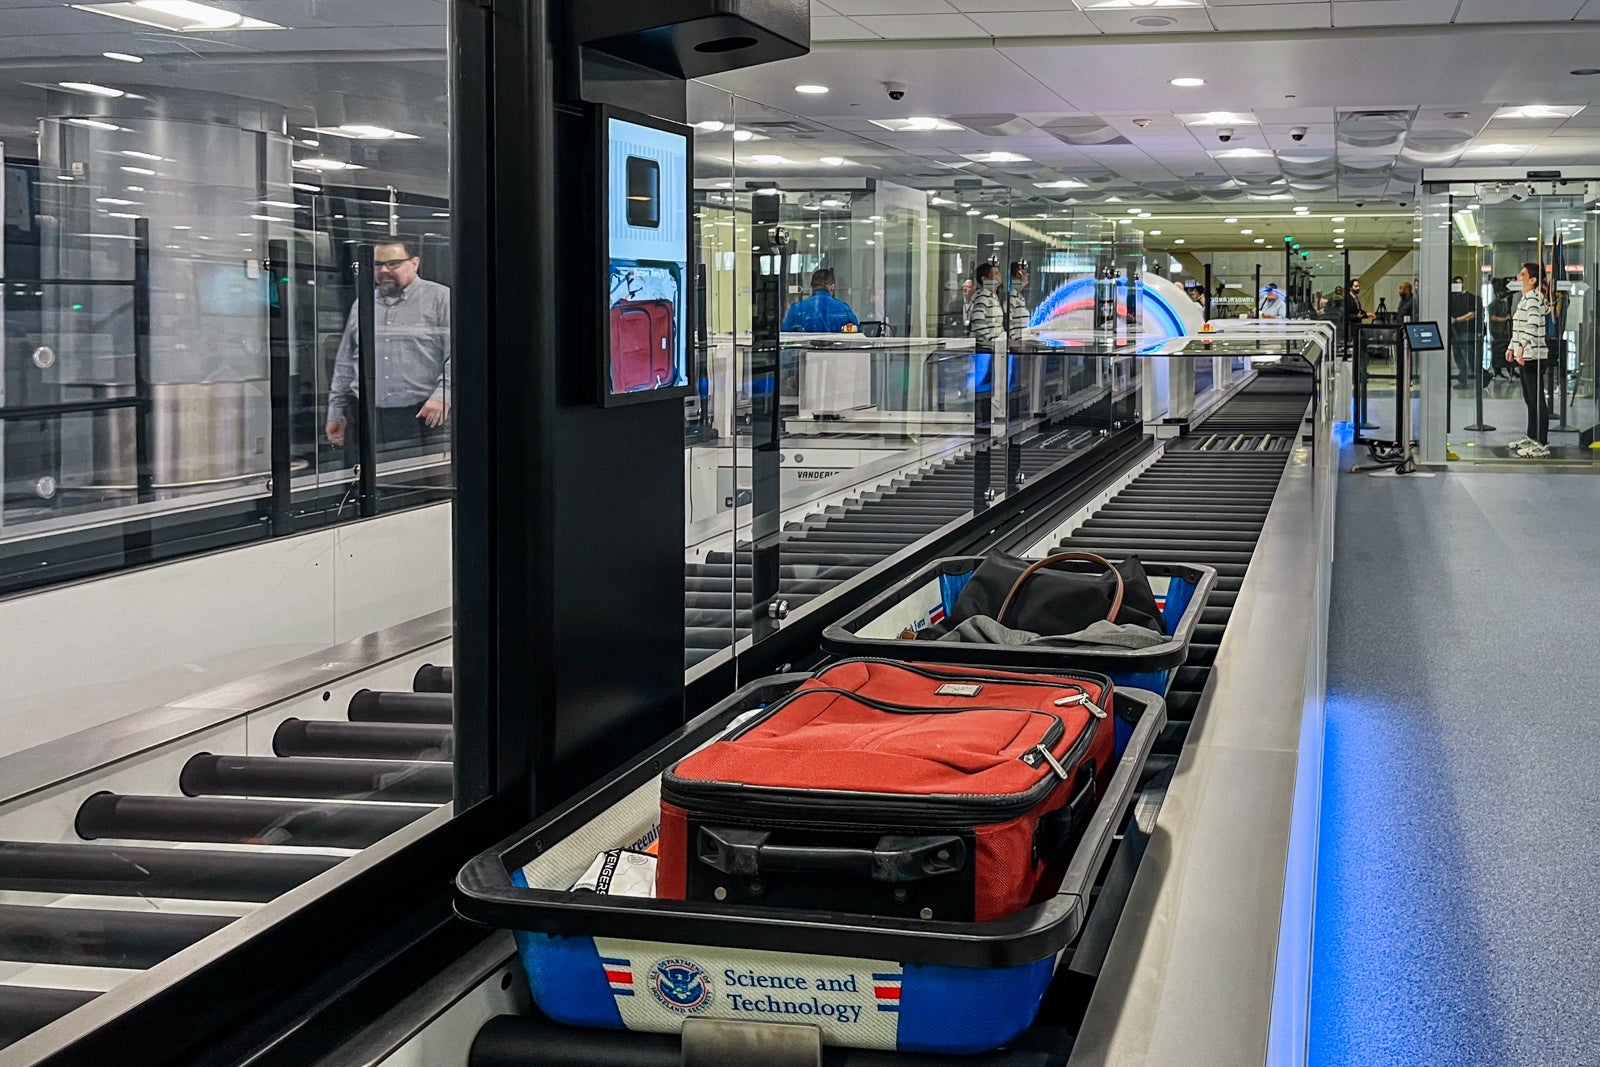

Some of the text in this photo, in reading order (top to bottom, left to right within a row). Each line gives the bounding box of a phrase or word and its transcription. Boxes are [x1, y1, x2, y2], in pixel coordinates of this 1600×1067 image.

[596, 849, 620, 895] VENGERS
[724, 968, 858, 993] Science and
[727, 994, 862, 1023] Technology
